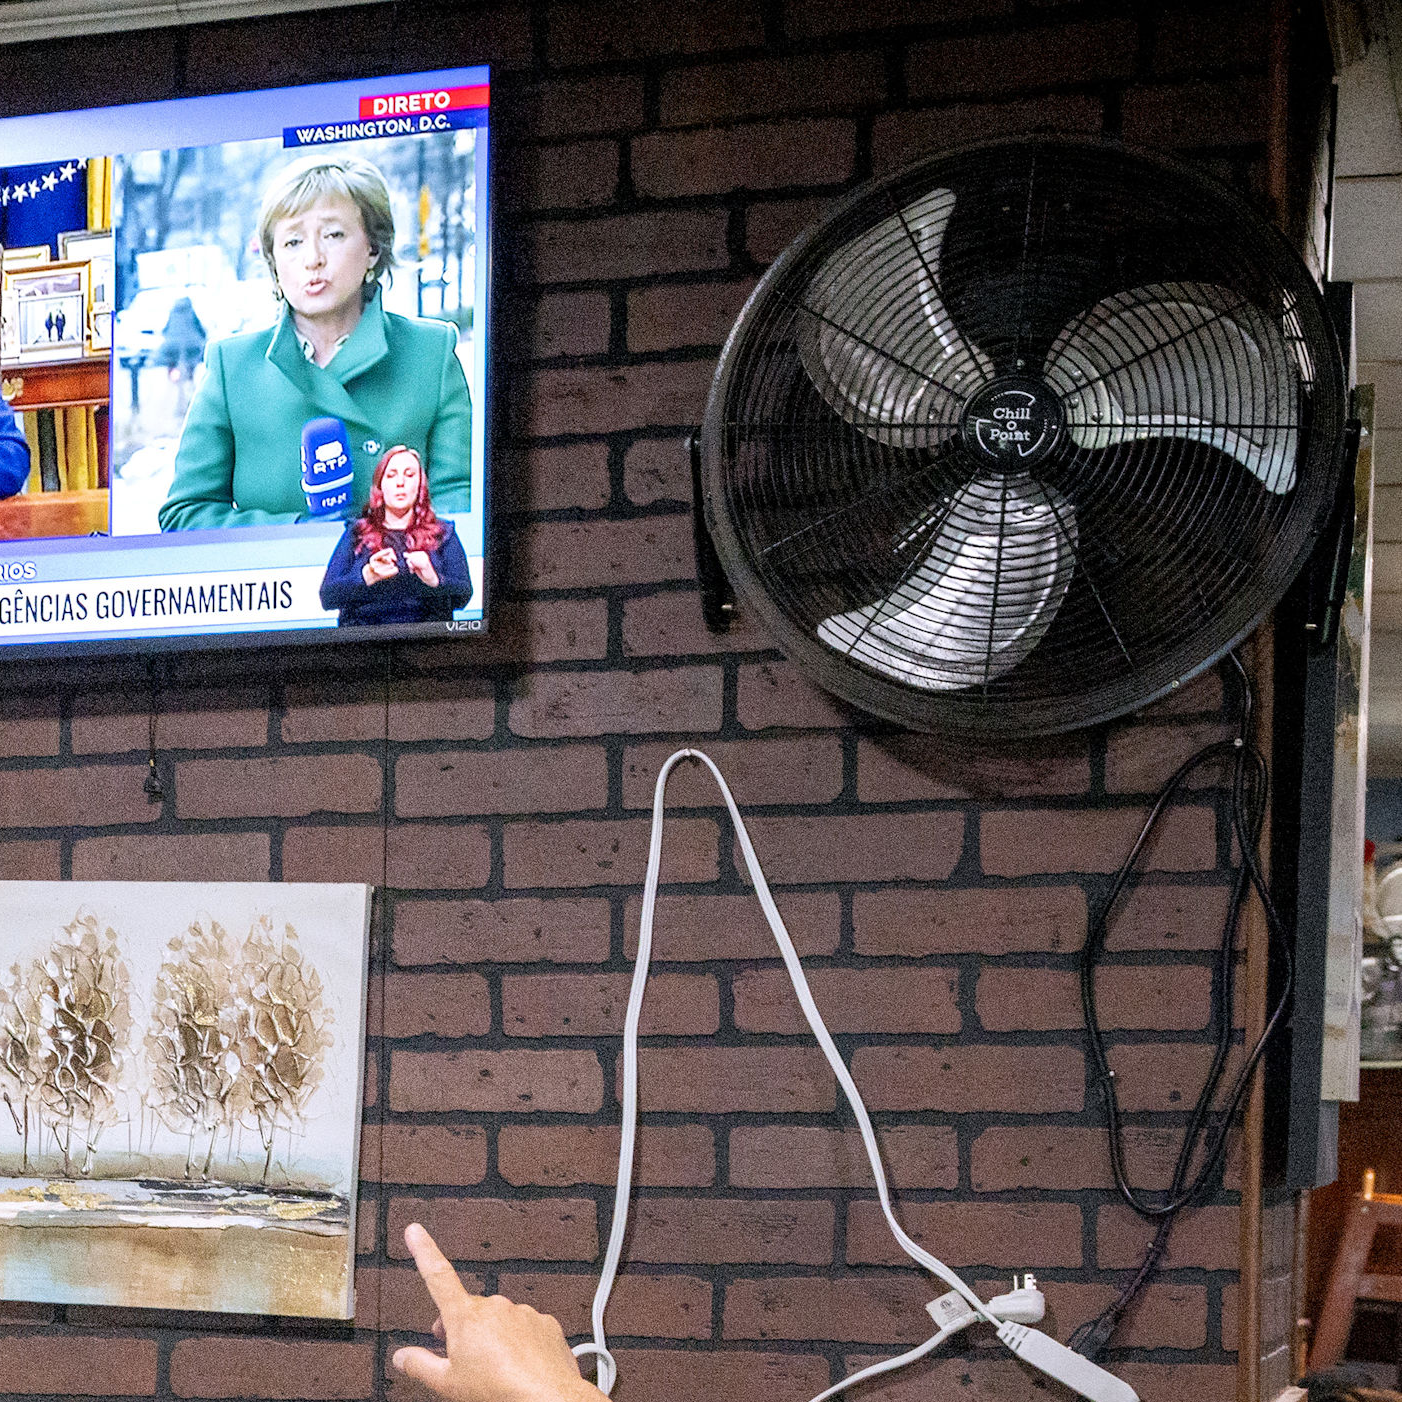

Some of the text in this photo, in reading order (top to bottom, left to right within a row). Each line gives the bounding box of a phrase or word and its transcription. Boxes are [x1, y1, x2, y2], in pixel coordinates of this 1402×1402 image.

[373, 91, 451, 115] DIRETO
[419, 114, 452, 132] D.C.
[993, 408, 1030, 420] Chill
[989, 428, 1031, 441] Point
[313, 454, 348, 475] RTP
[95, 580, 293, 620] GOVERNAMENTAIS
[445, 620, 482, 633] VIZIO
